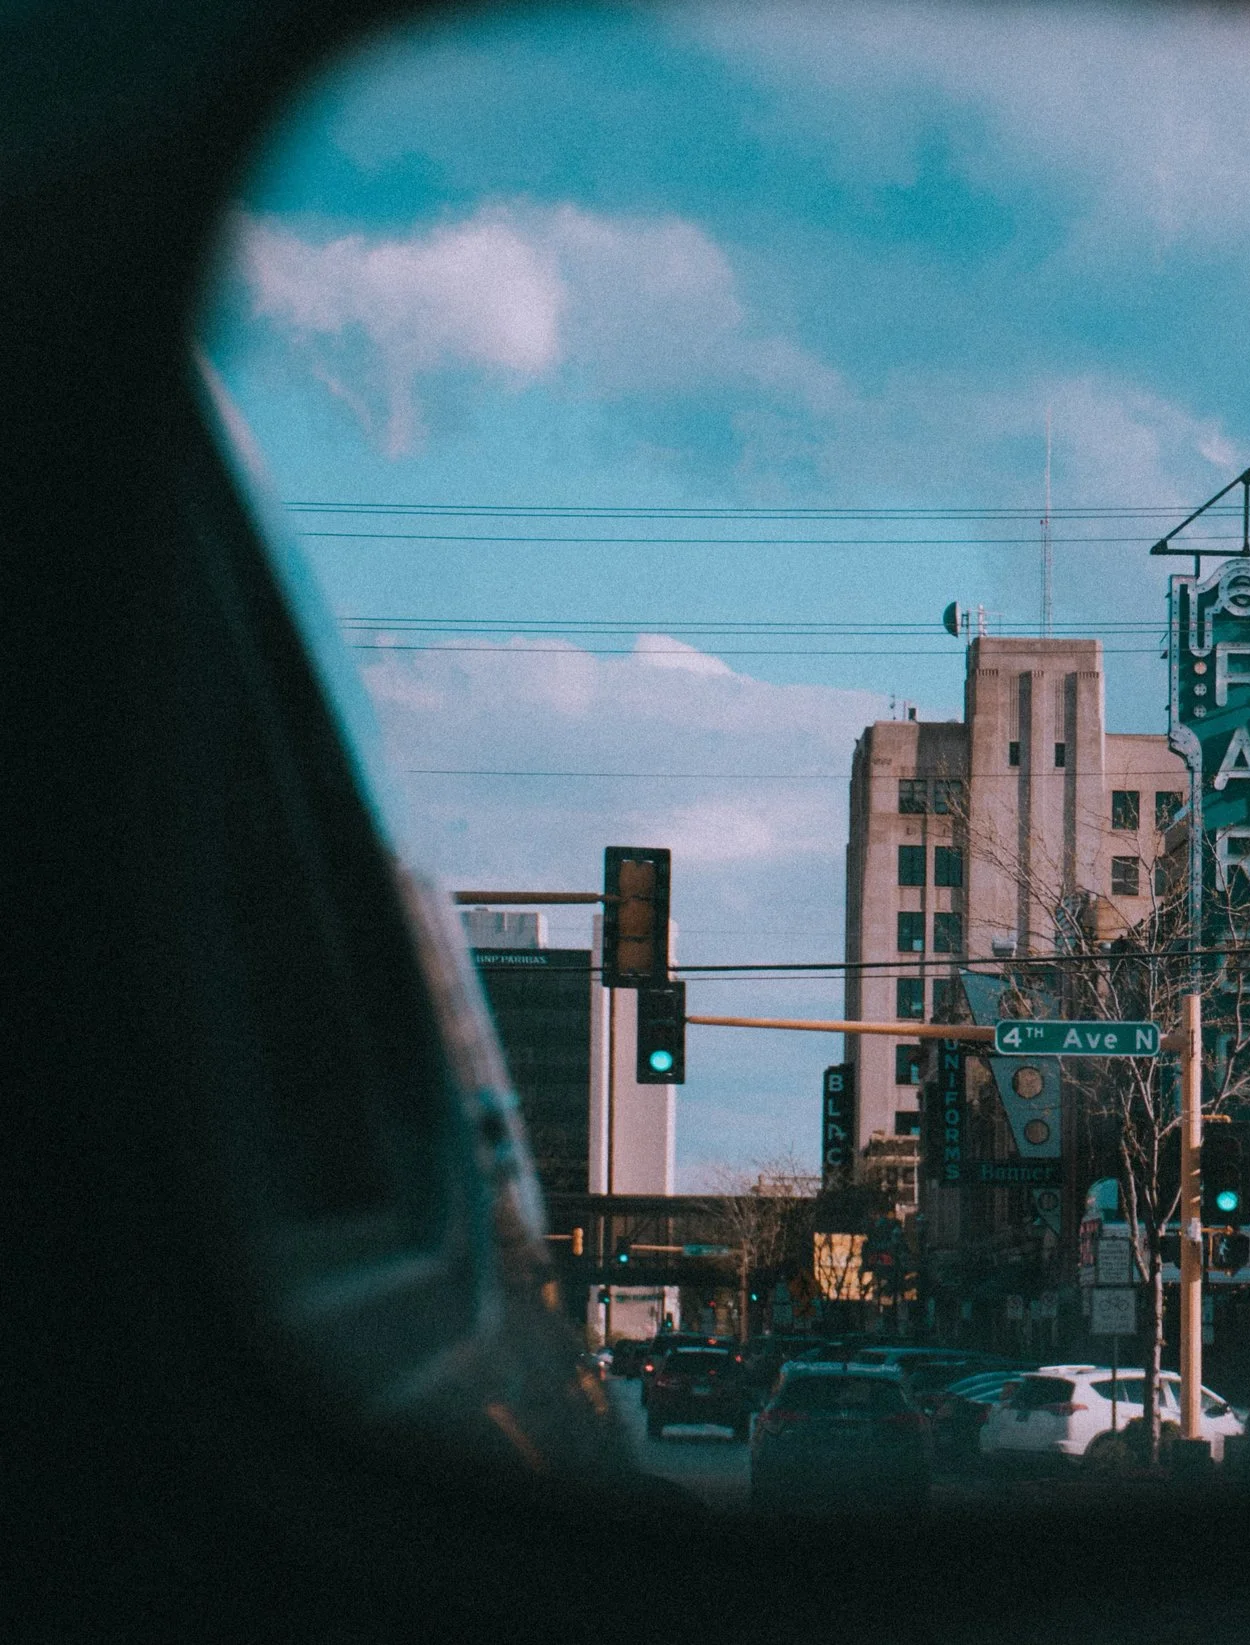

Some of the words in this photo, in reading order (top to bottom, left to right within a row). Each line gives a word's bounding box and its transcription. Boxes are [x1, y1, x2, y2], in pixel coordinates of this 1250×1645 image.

[1003, 1027, 1044, 1049] 4TH
[1063, 1027, 1118, 1050] Ave
[1135, 1028, 1153, 1050] N
[944, 1037, 961, 1180] UNIFORMS
